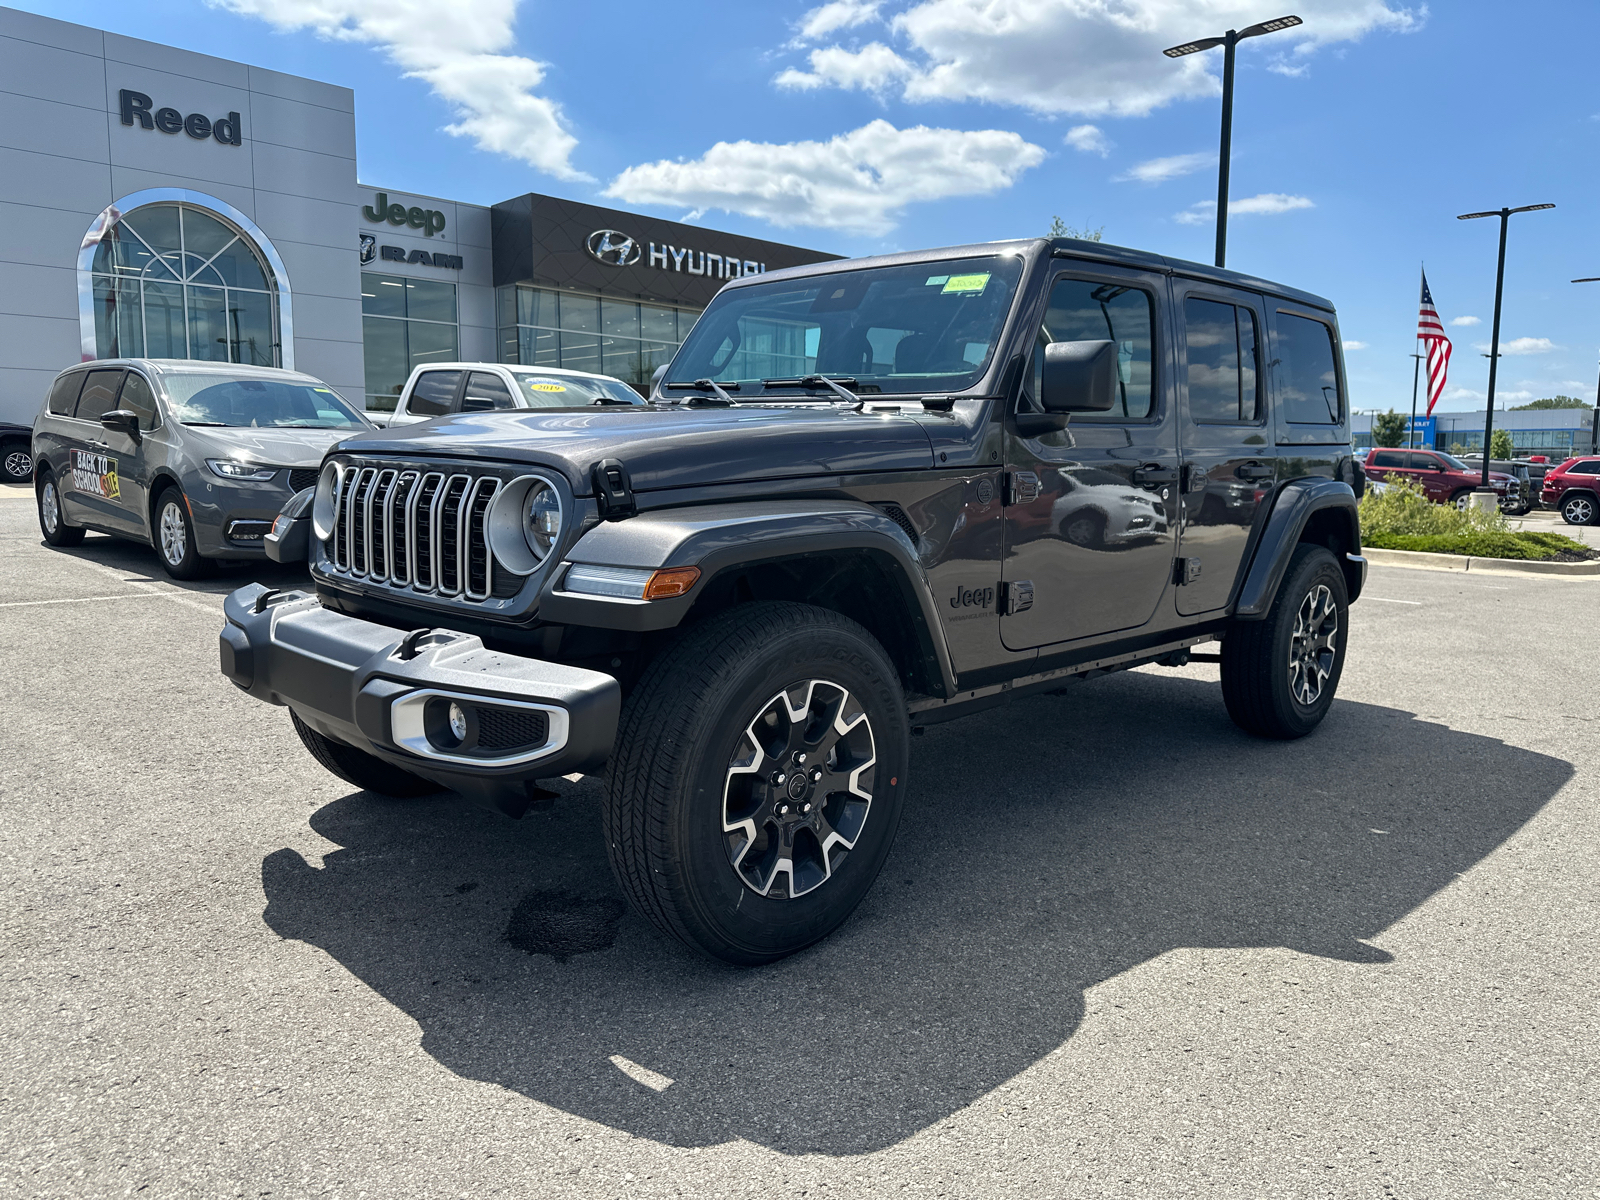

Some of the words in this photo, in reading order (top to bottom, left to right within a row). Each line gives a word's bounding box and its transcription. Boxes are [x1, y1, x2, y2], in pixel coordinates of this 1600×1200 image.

[119, 88, 242, 146] Reed
[362, 192, 446, 236] Jeep
[381, 245, 464, 270] RAM
[77, 451, 96, 472] BACK
[97, 455, 108, 475] TO
[72, 468, 105, 495] SCHOOL
[102, 474, 118, 497] SALE
[950, 585, 995, 608] Jeep
[948, 612, 988, 622] WRANGLER
